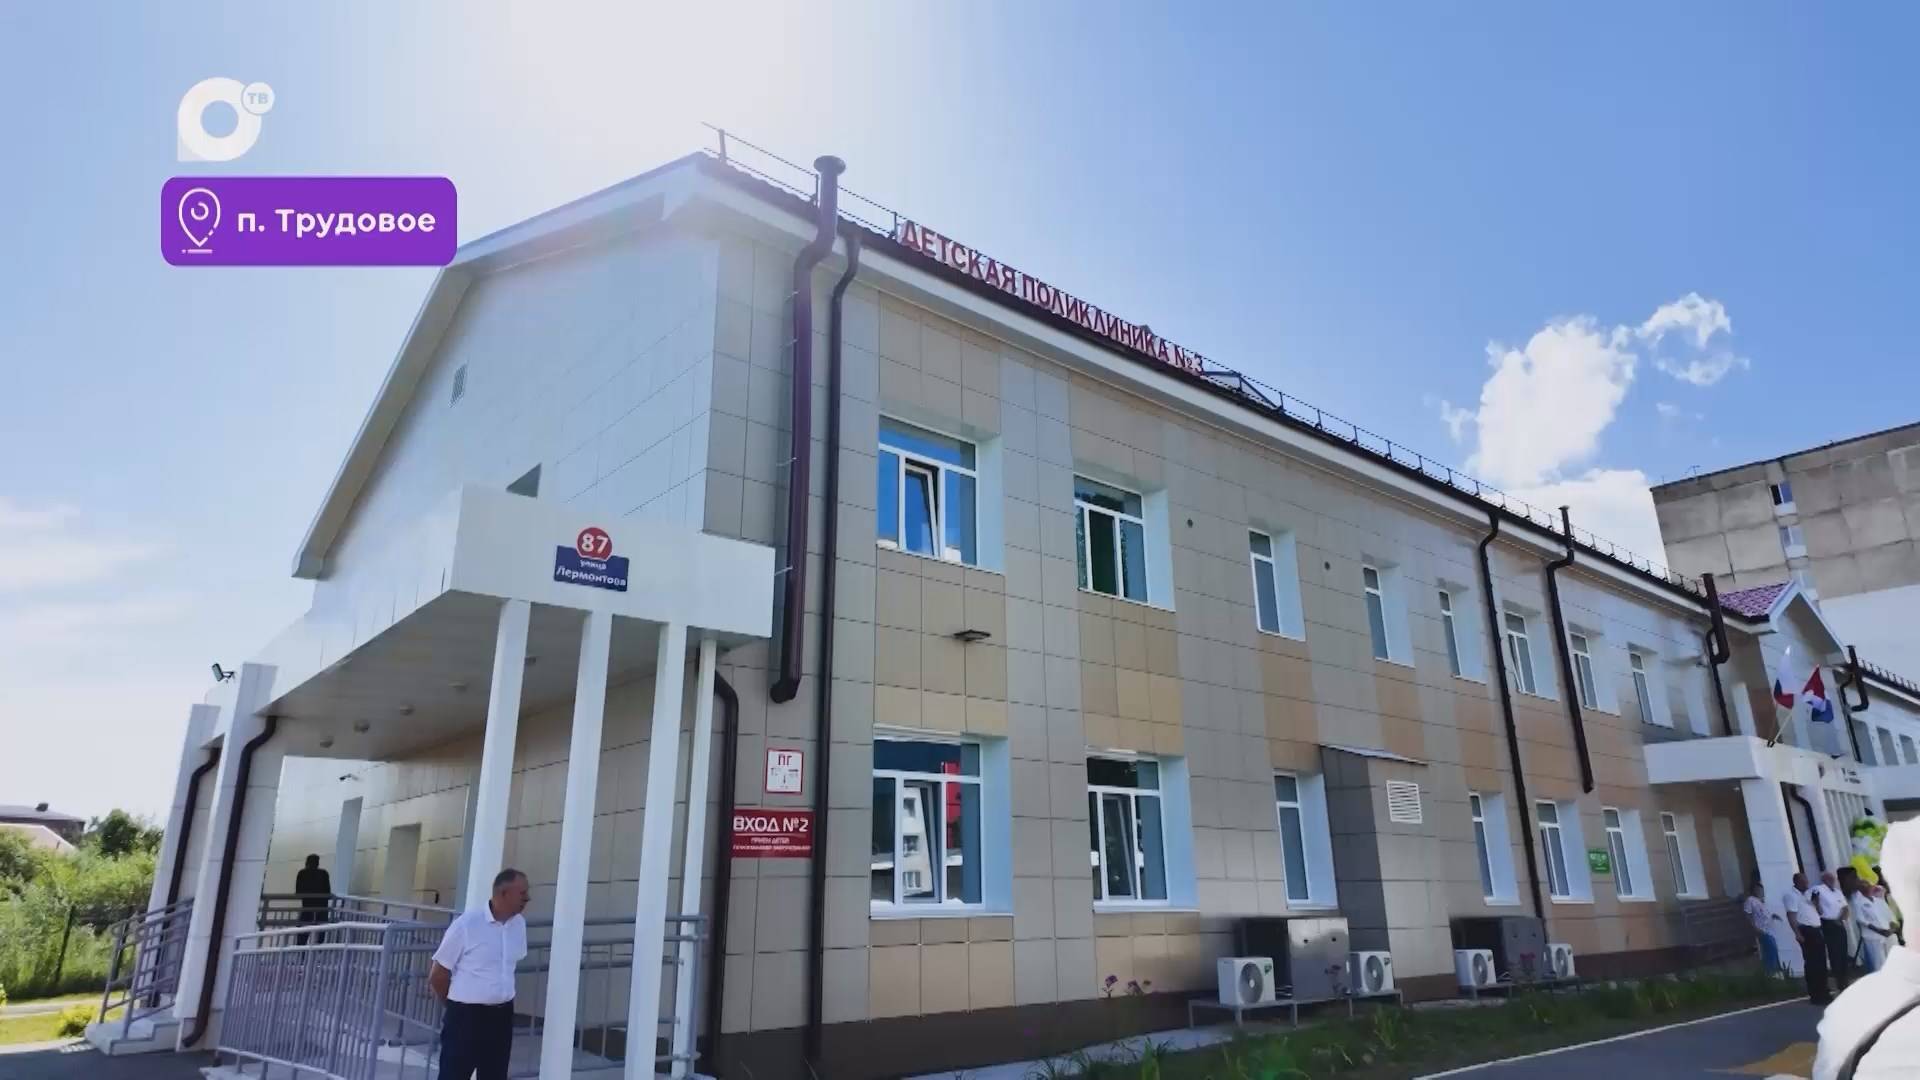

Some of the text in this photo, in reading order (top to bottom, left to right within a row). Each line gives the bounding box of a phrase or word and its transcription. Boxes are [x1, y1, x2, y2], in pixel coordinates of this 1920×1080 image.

[901, 219, 1017, 295] ДЕТСКАЯ
[1023, 273, 1169, 362] ПОЛИКЛИНИКА
[582, 533, 608, 553] 87
[556, 566, 626, 586] Лермонтова
[733, 816, 809, 832] ВХОД №2
